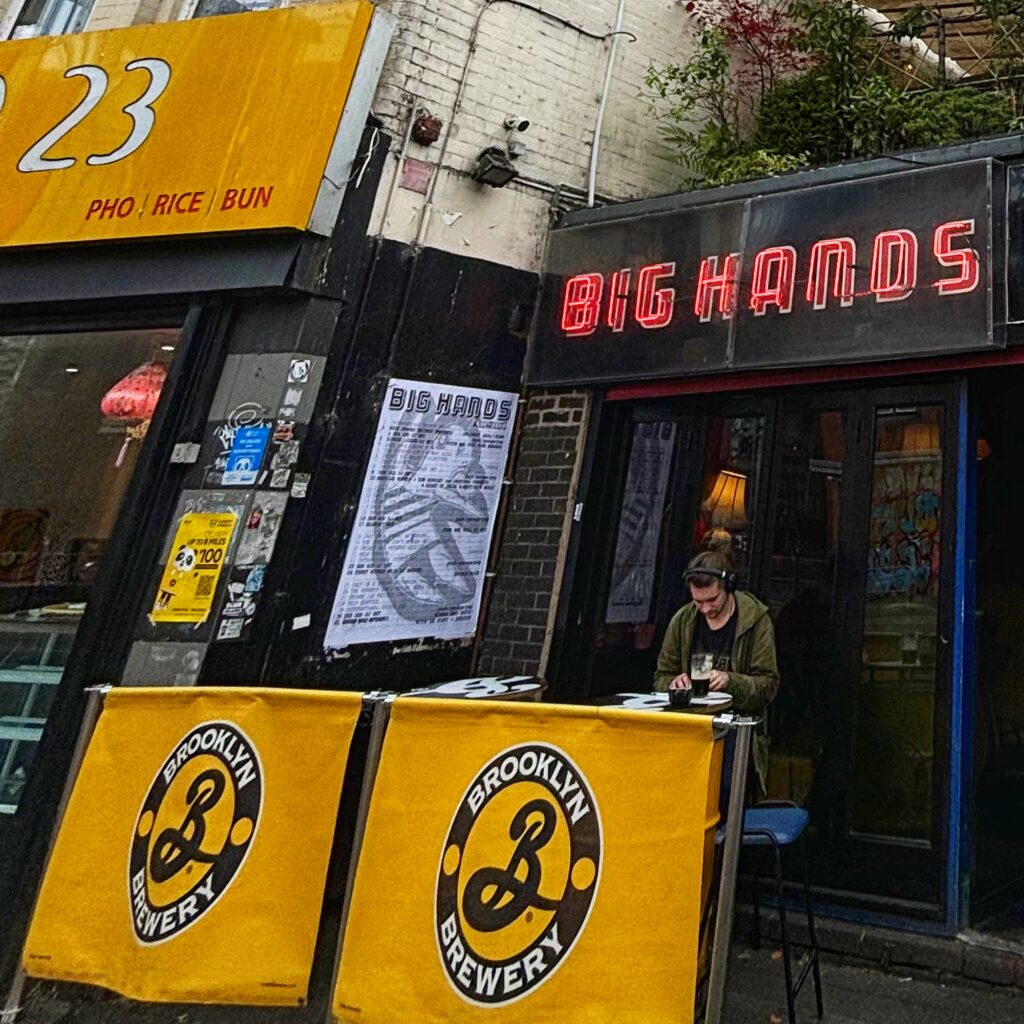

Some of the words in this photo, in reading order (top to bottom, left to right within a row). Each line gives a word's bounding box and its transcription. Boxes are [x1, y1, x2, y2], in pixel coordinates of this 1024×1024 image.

[17, 57, 172, 173] 23
[85, 197, 134, 220] PHO
[152, 190, 205, 215] RICE
[220, 186, 275, 211] BUN
[561, 261, 676, 338] BIG
[695, 218, 980, 323] HANDS
[388, 388, 431, 412] BIG
[435, 392, 512, 421] HANDS
[163, 728, 256, 790] BROOKLYN
[467, 751, 591, 826] BROOKLYN
[132, 867, 215, 937] BREWERY
[440, 911, 564, 996] BREWERY
